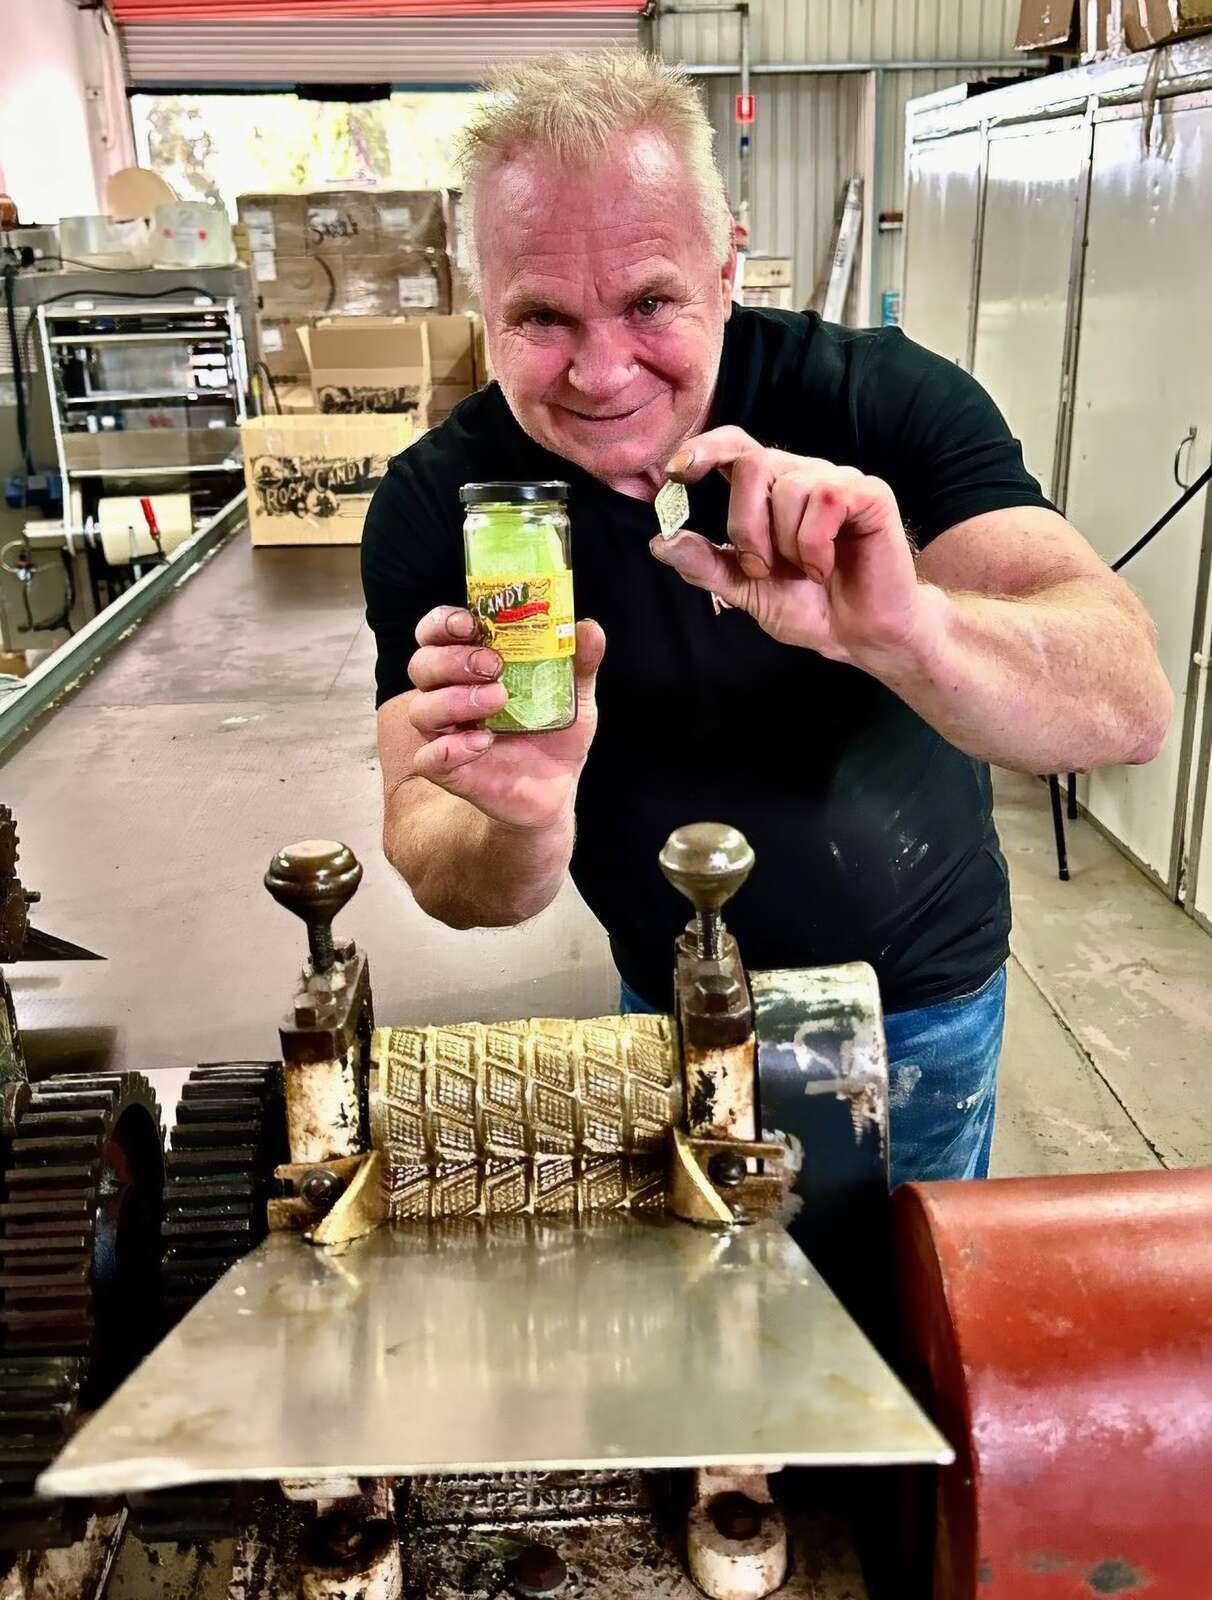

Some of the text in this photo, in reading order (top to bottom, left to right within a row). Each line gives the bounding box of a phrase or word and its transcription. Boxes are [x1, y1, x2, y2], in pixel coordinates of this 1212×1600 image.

[266, 457, 368, 511] ROCK CANDY
[477, 583, 524, 620] CANDY
